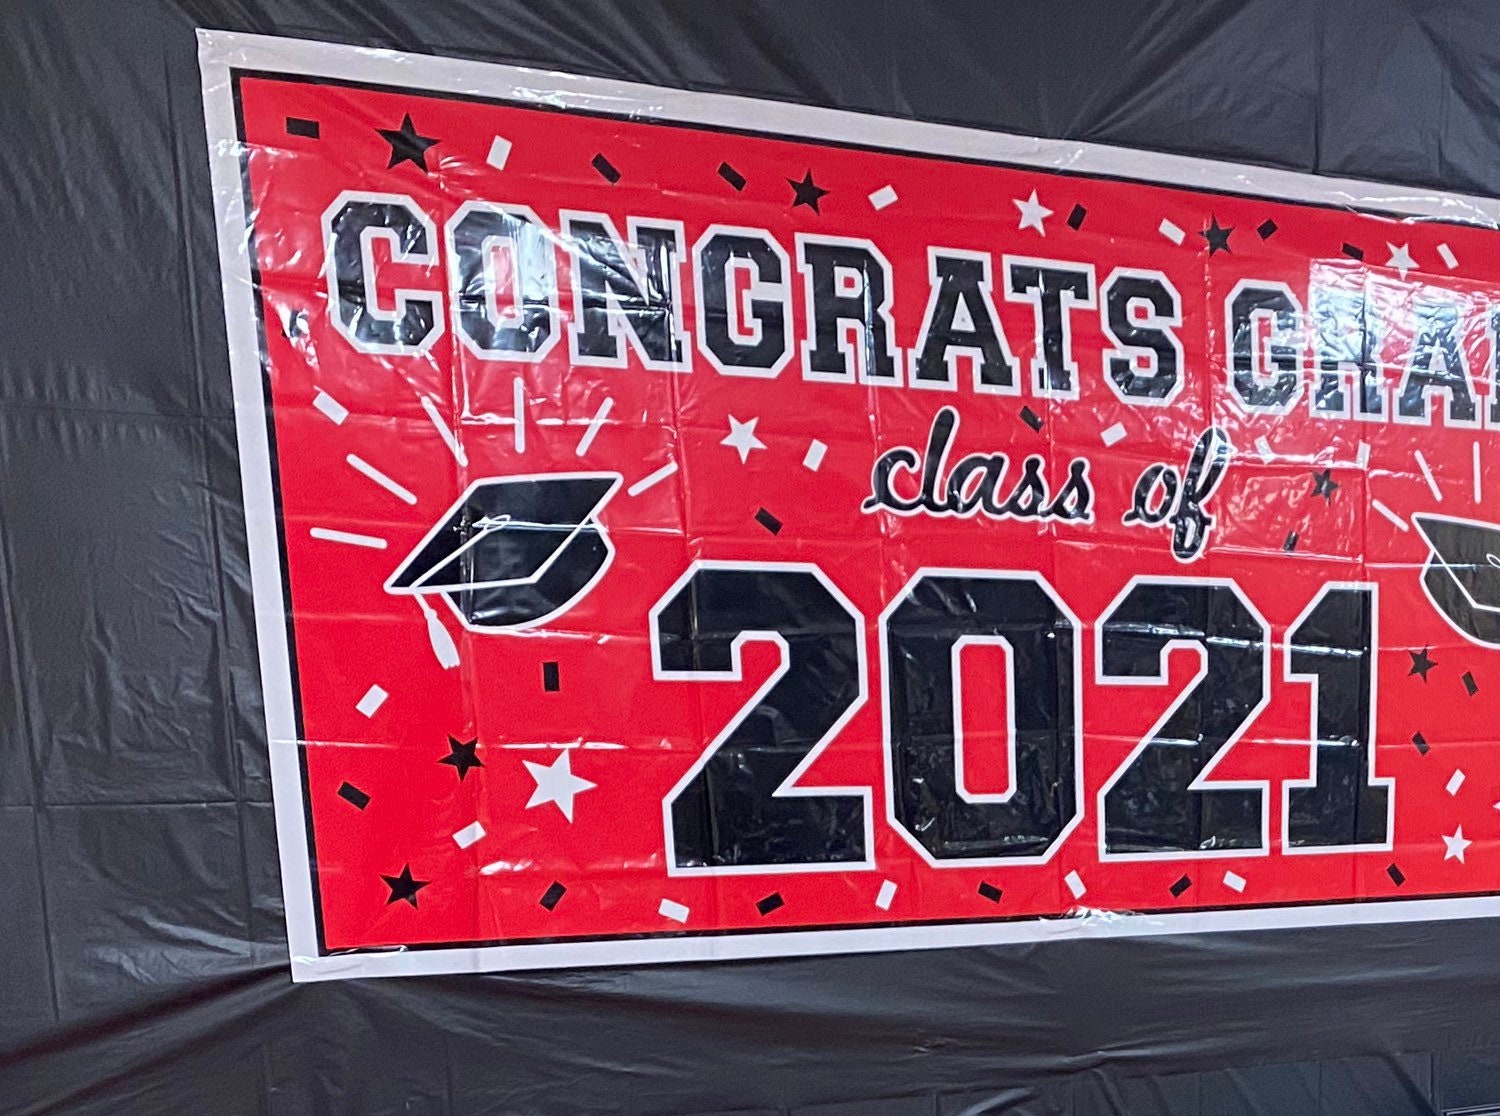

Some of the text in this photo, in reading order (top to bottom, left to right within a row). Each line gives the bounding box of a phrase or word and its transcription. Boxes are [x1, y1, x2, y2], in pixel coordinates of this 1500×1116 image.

[320, 190, 1185, 407] CONGRATS
[862, 405, 1233, 564] class of
[650, 560, 1396, 877] 2021
